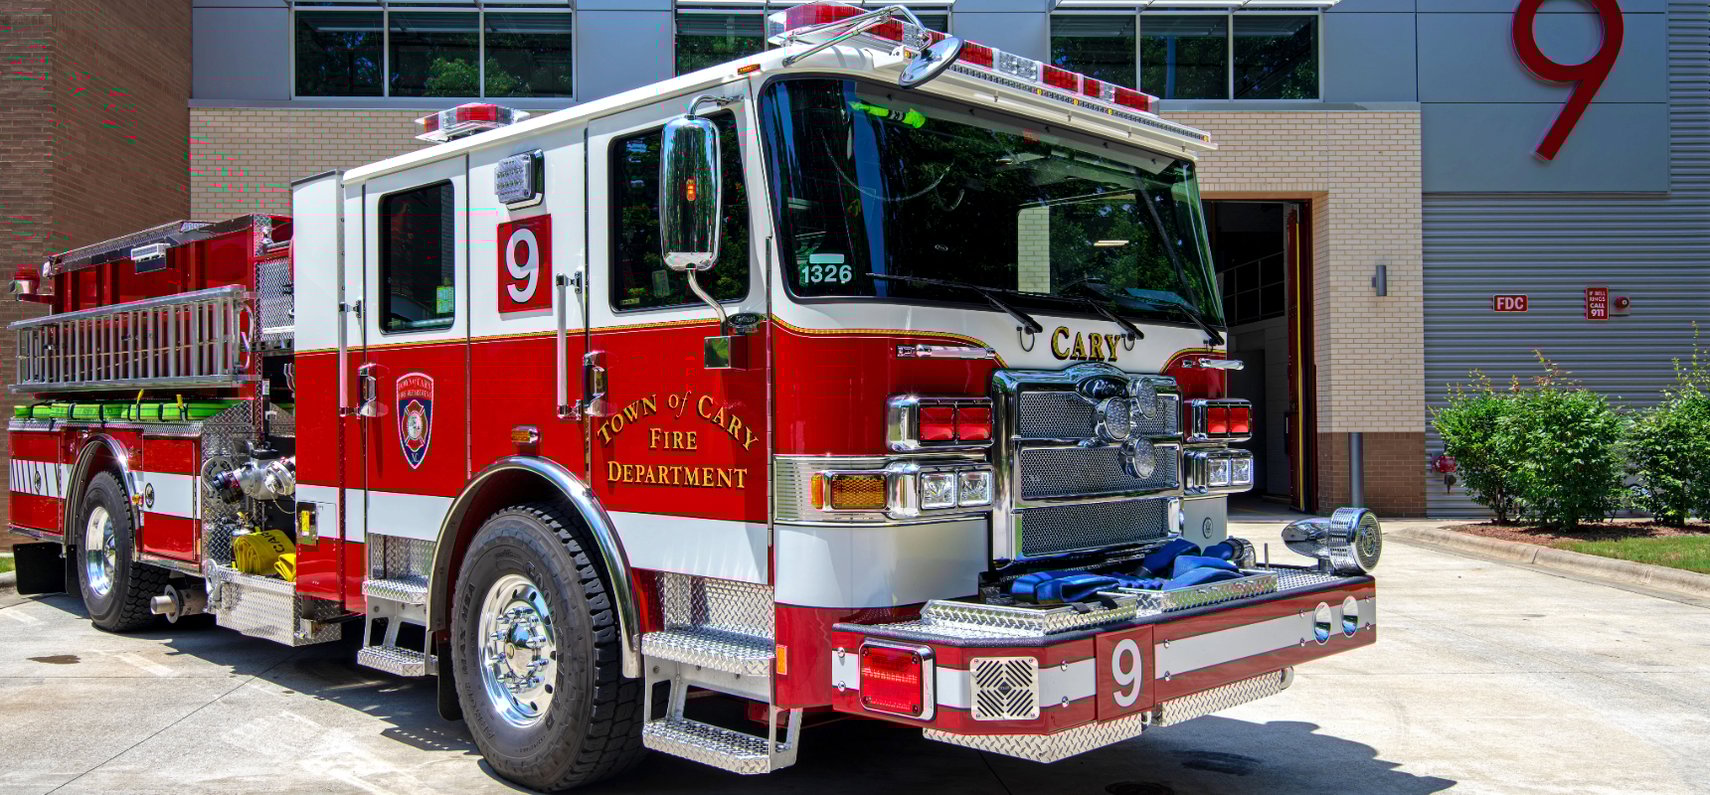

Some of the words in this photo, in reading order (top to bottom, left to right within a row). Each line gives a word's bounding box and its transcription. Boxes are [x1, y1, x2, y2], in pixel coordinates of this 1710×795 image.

[1512, 0, 1624, 161] 9
[506, 228, 539, 303] 9
[801, 264, 852, 284] 1326
[1496, 296, 1524, 310] FDC
[1591, 308, 1605, 317] 911
[1051, 326, 1121, 362] CARY
[597, 394, 658, 445] TOWN
[668, 391, 692, 418] of
[697, 394, 760, 451] CARY
[650, 427, 698, 450] FIRE
[607, 460, 748, 489] DEPARTMENT
[1111, 638, 1142, 707] 9
